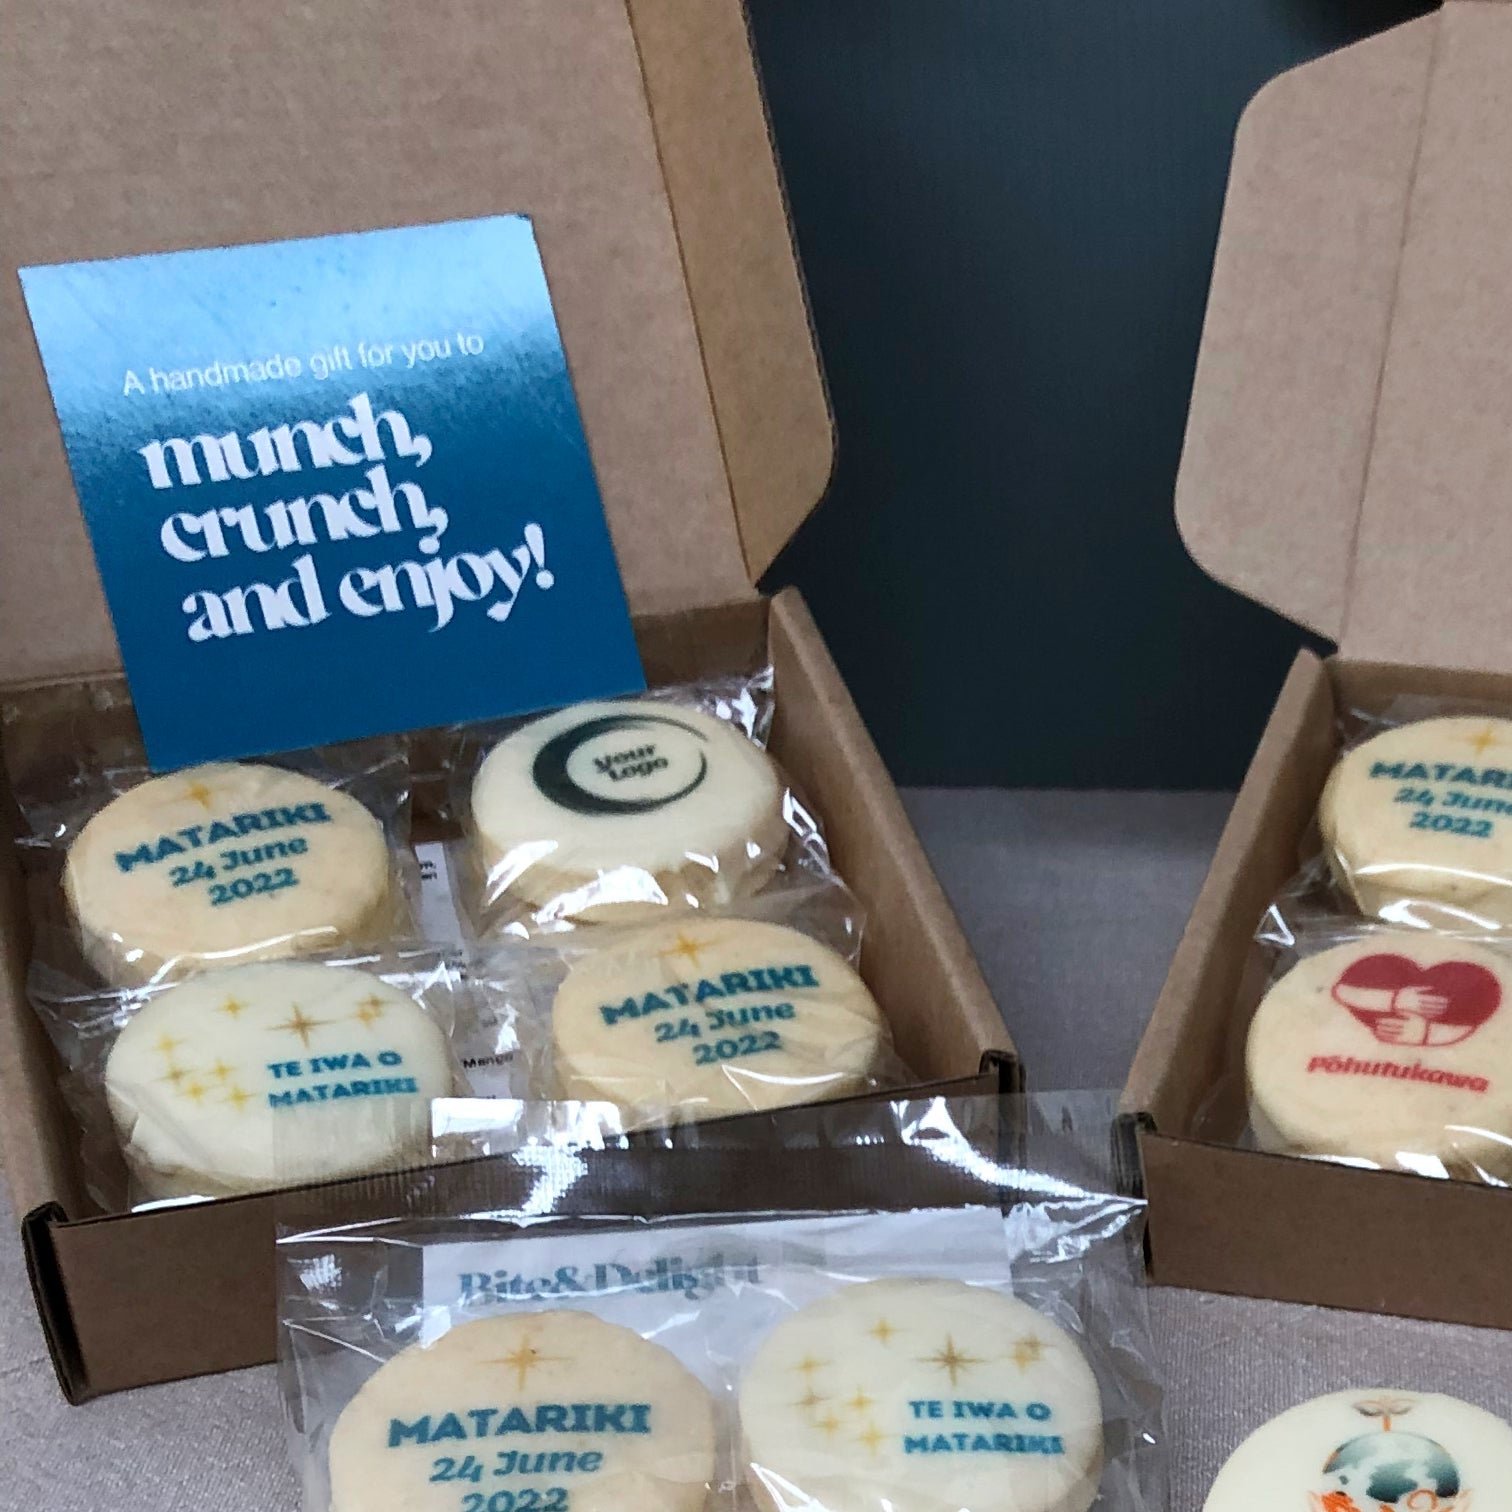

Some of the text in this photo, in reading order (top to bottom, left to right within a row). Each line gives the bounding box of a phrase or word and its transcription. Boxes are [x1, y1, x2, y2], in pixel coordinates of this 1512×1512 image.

[122, 333, 484, 396] A handmade gift for you to
[139, 391, 432, 489] munch,
[160, 464, 449, 562] crunch,
[181, 522, 554, 642] and enjoy!
[1394, 787, 1435, 807] 24
[114, 802, 334, 873] MATARIKI
[1409, 811, 1494, 839] 2022
[169, 836, 309, 888] 24 June
[209, 868, 299, 906] 2022
[601, 965, 819, 1025] MATARIKI
[654, 1002, 796, 1044] 24 June
[267, 1051, 402, 1079] TE IWA O
[694, 1031, 782, 1066] 2022
[267, 1077, 419, 1109] MATARIKI
[387, 1403, 651, 1449] MATARIKI
[908, 1400, 1052, 1421] TE IWA O
[903, 1433, 1066, 1456] MATARIKI
[429, 1450, 604, 1484] 24 June
